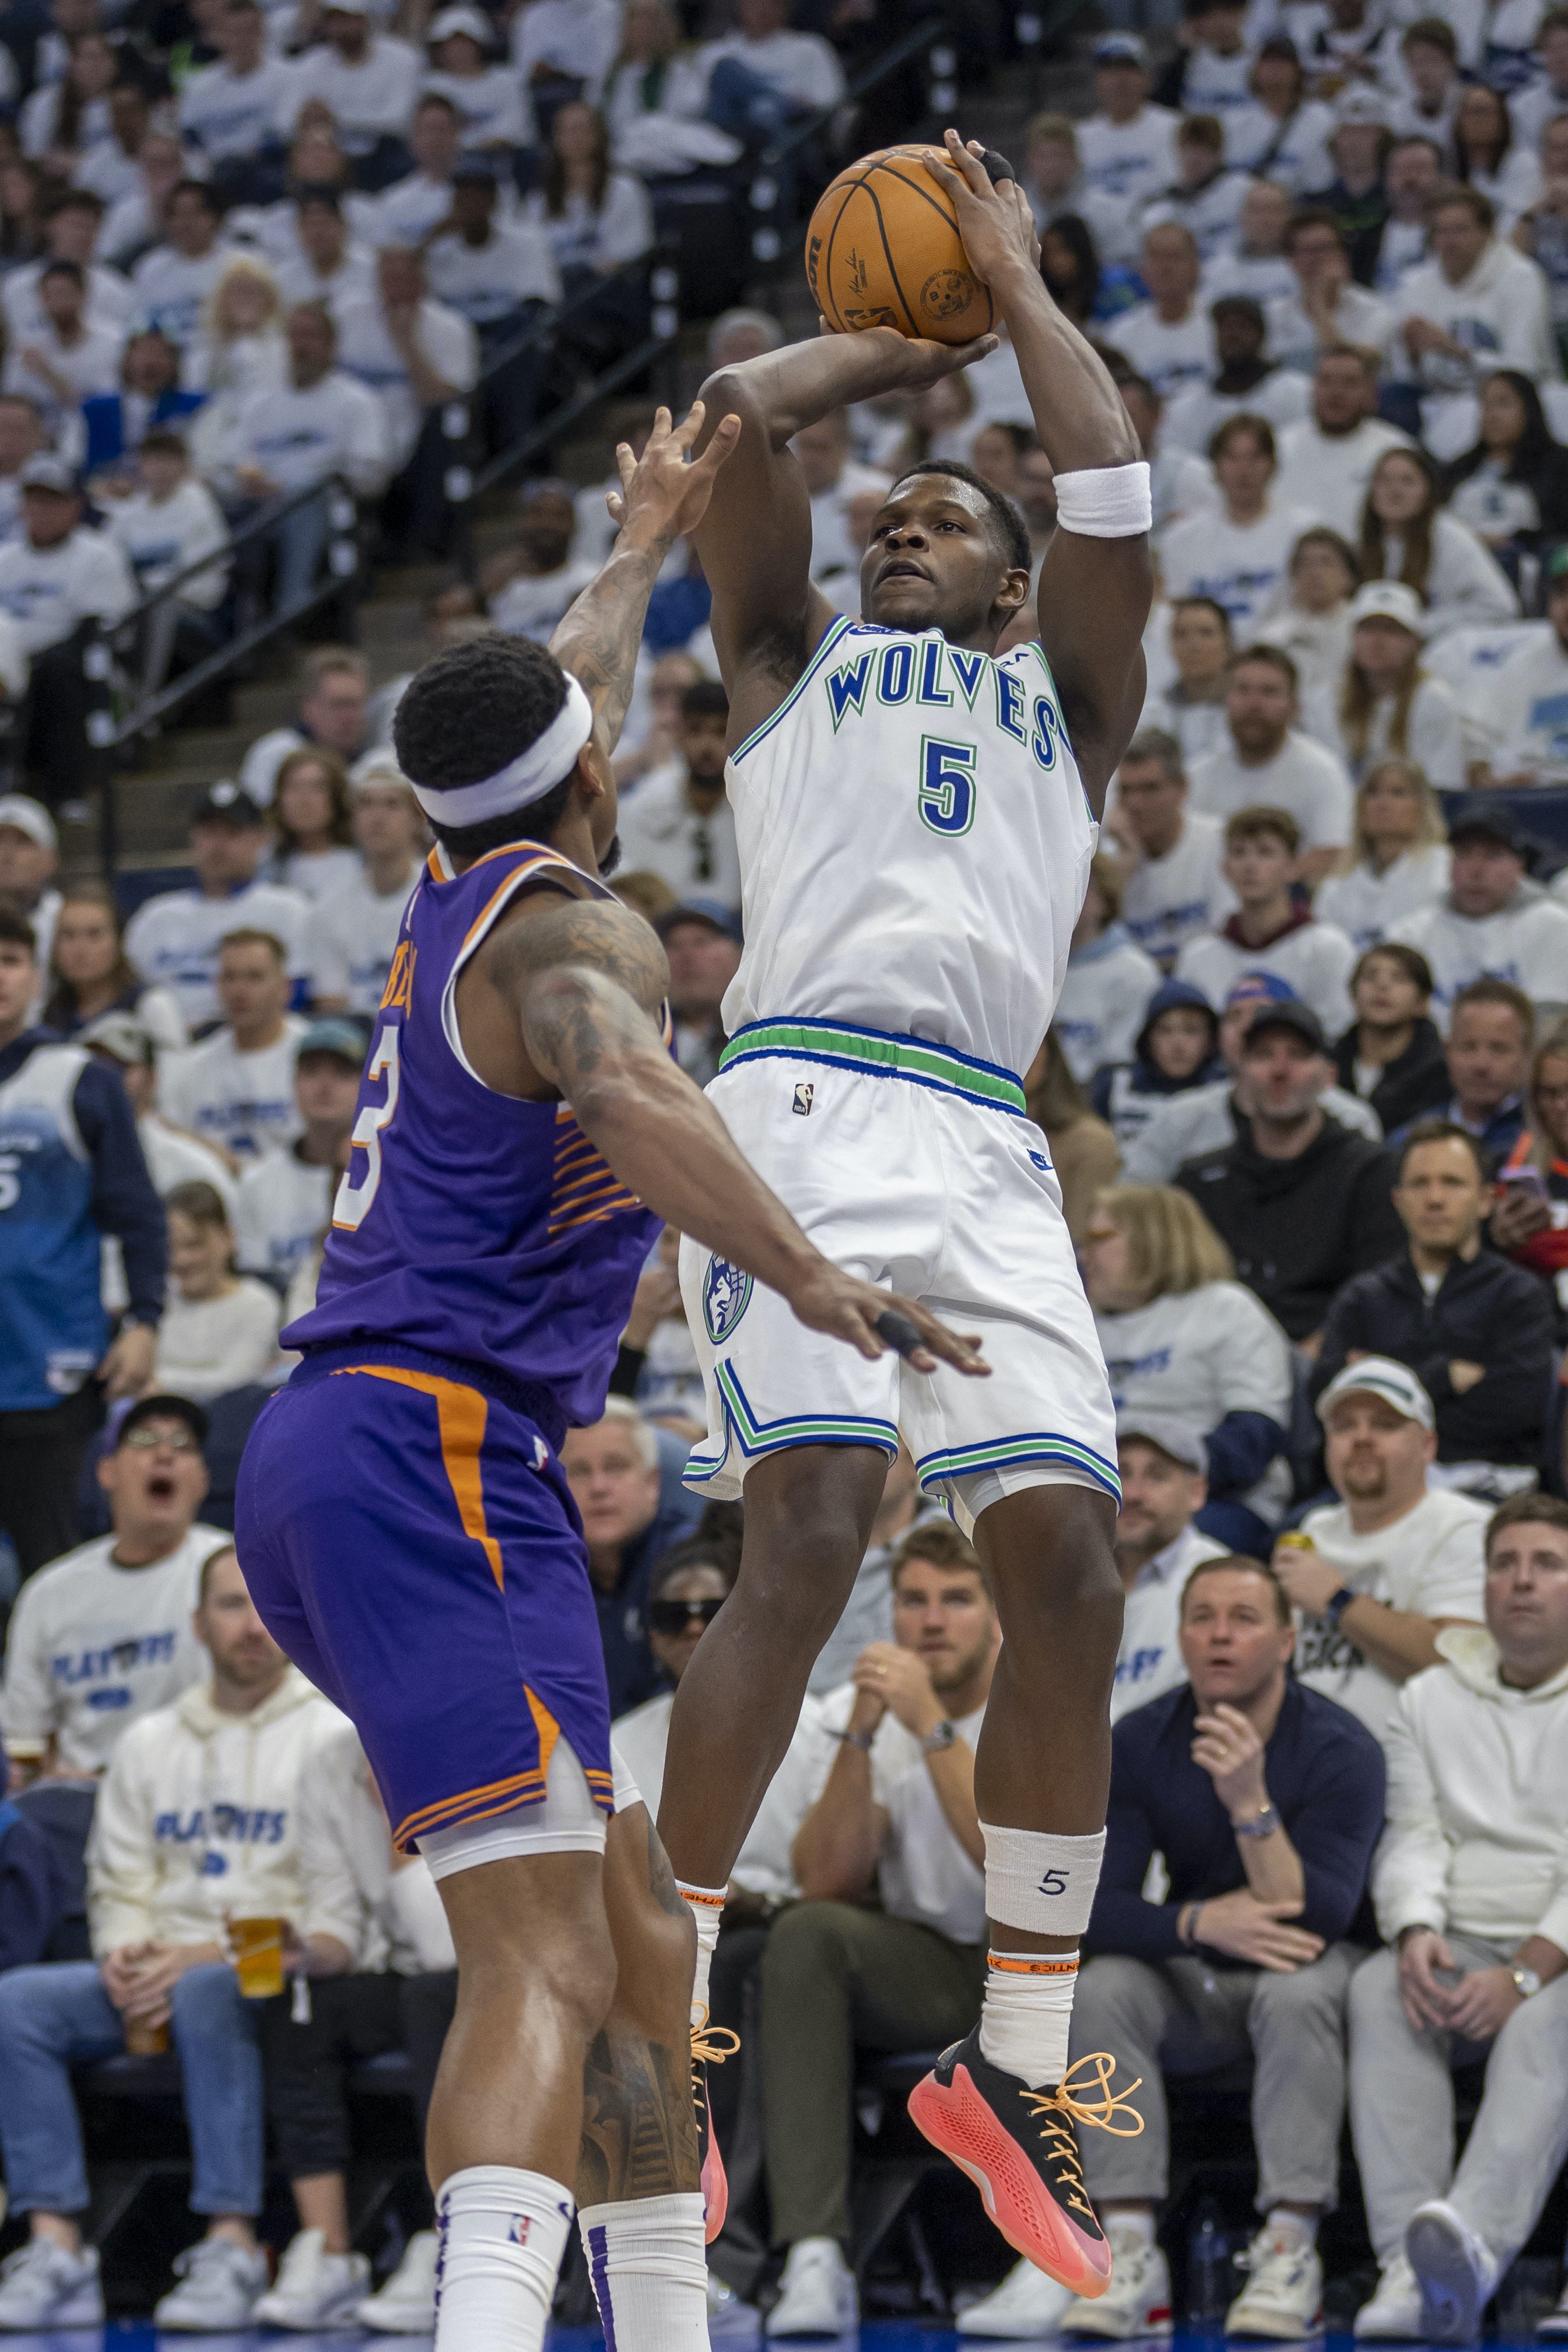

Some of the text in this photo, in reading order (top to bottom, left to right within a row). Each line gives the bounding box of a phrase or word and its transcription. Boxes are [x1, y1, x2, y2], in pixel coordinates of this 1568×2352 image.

[825, 639, 1060, 772] WOLVES
[918, 734, 977, 837] 5
[332, 1025, 401, 1233] 3
[1037, 1869, 1070, 1896] 5
